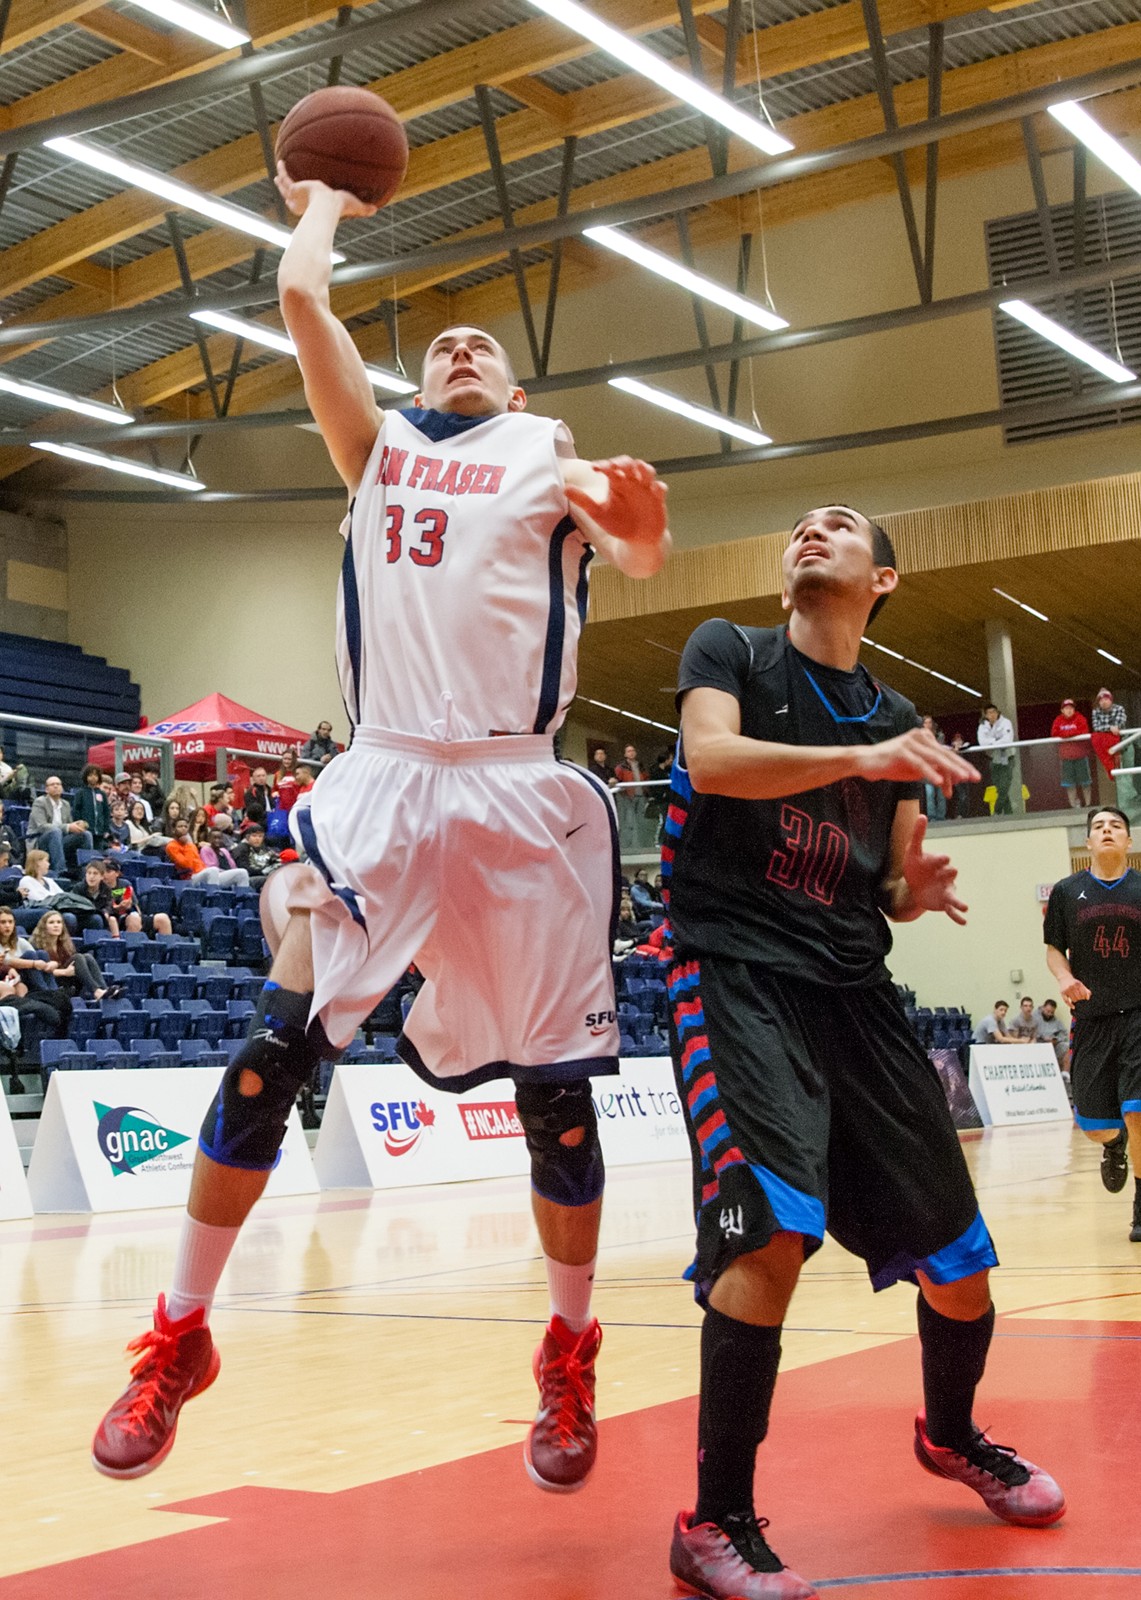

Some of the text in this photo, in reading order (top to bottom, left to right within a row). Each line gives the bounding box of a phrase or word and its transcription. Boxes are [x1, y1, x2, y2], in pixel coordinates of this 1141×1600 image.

[407, 455, 506, 495] FRASER
[386, 504, 449, 568] 33
[766, 803, 849, 905] 30
[1093, 925, 1130, 958] 44
[585, 1010, 616, 1026] SFU
[983, 1062, 1057, 1081] CHARTER BUS LINES
[370, 1100, 421, 1132] SFU
[106, 1128, 169, 1163] gnac
[148, 1153, 184, 1163] Northwest
[141, 1163, 167, 1173] Athletic
